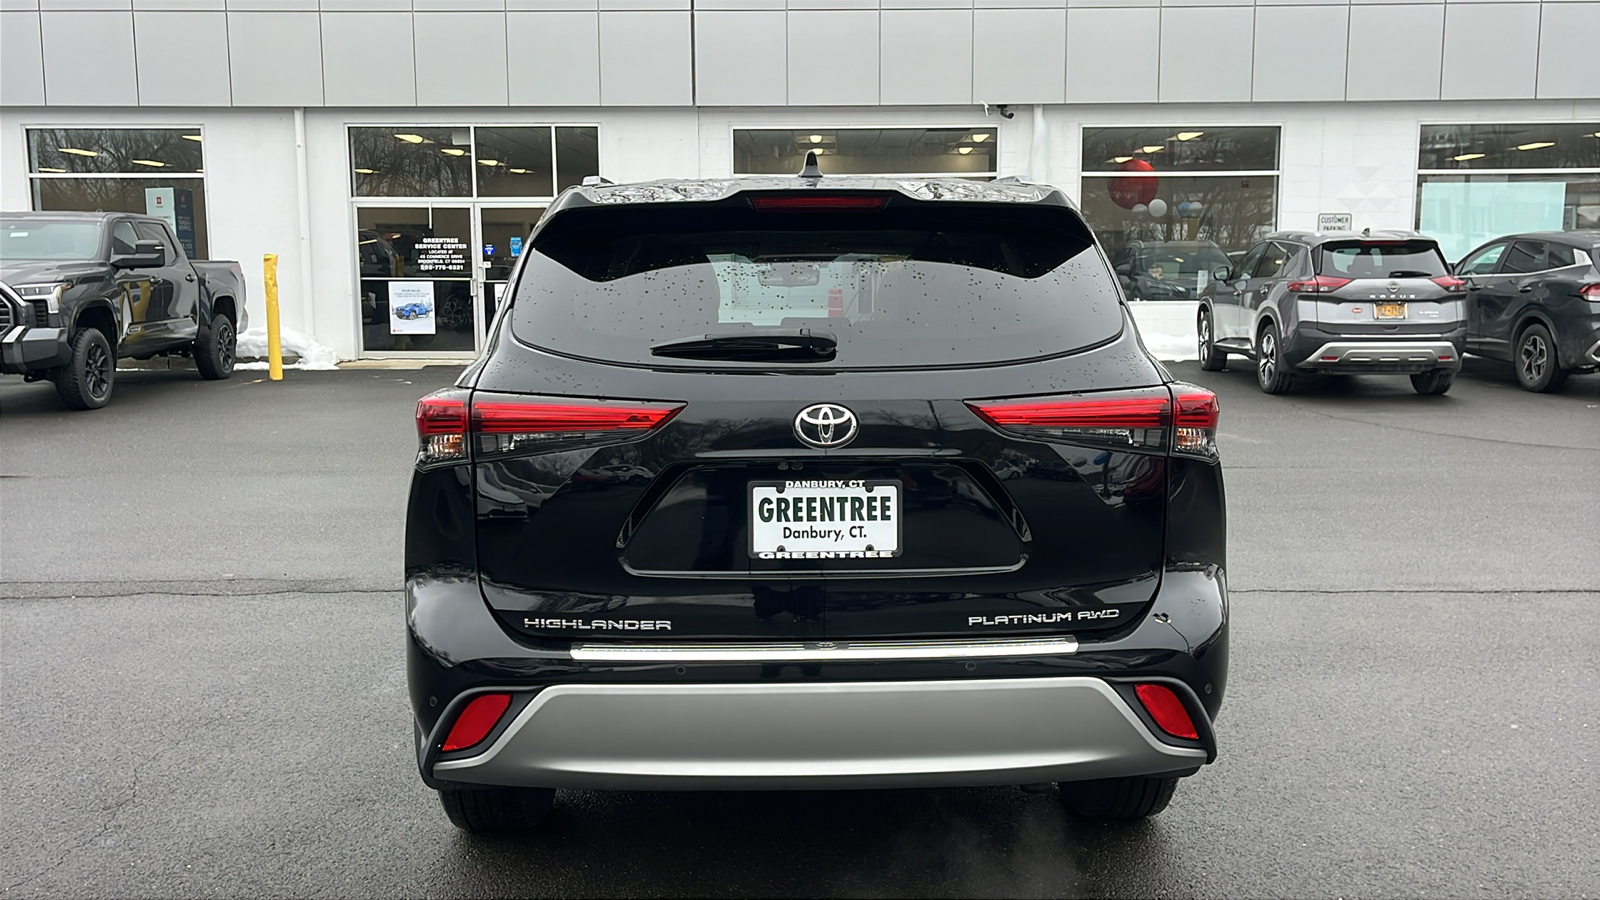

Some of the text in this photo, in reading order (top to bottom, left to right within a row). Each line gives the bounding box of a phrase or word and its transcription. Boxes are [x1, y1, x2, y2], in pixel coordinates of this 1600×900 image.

[1320, 216, 1349, 224] CUSTOMER
[785, 480, 866, 489] DANBURY, CT
[758, 496, 892, 523] GREENTREE
[783, 525, 867, 542] Danbury, CT.
[758, 551, 894, 559] GREENTREE
[968, 609, 1120, 626] PLATINUM AWD
[524, 618, 672, 631] HIGHLANDER
